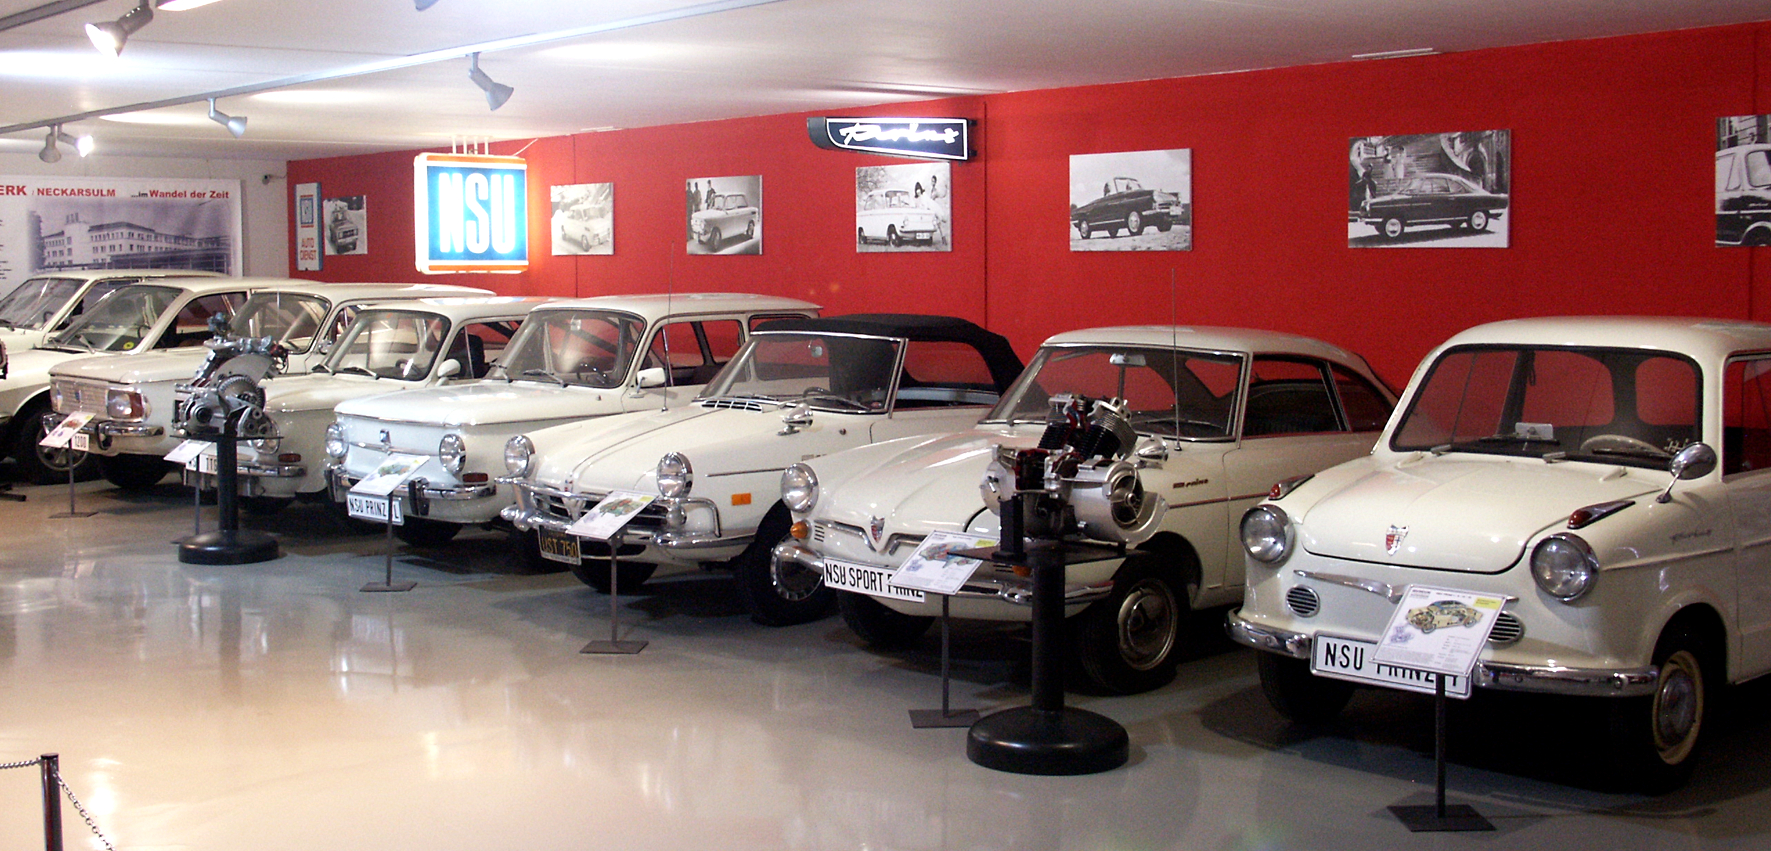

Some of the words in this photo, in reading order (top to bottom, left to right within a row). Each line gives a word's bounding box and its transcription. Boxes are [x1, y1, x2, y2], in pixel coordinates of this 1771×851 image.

[37, 188, 116, 197] NECKARSULM
[149, 189, 187, 198] Wandel
[190, 189, 206, 198] der
[209, 190, 229, 199] Zeit
[438, 172, 516, 254] NSU
[349, 498, 364, 513] NSU
[366, 500, 387, 517] PRINZ
[825, 563, 846, 586] NSU
[849, 567, 884, 592] SPORT
[1325, 642, 1364, 671] NSU
